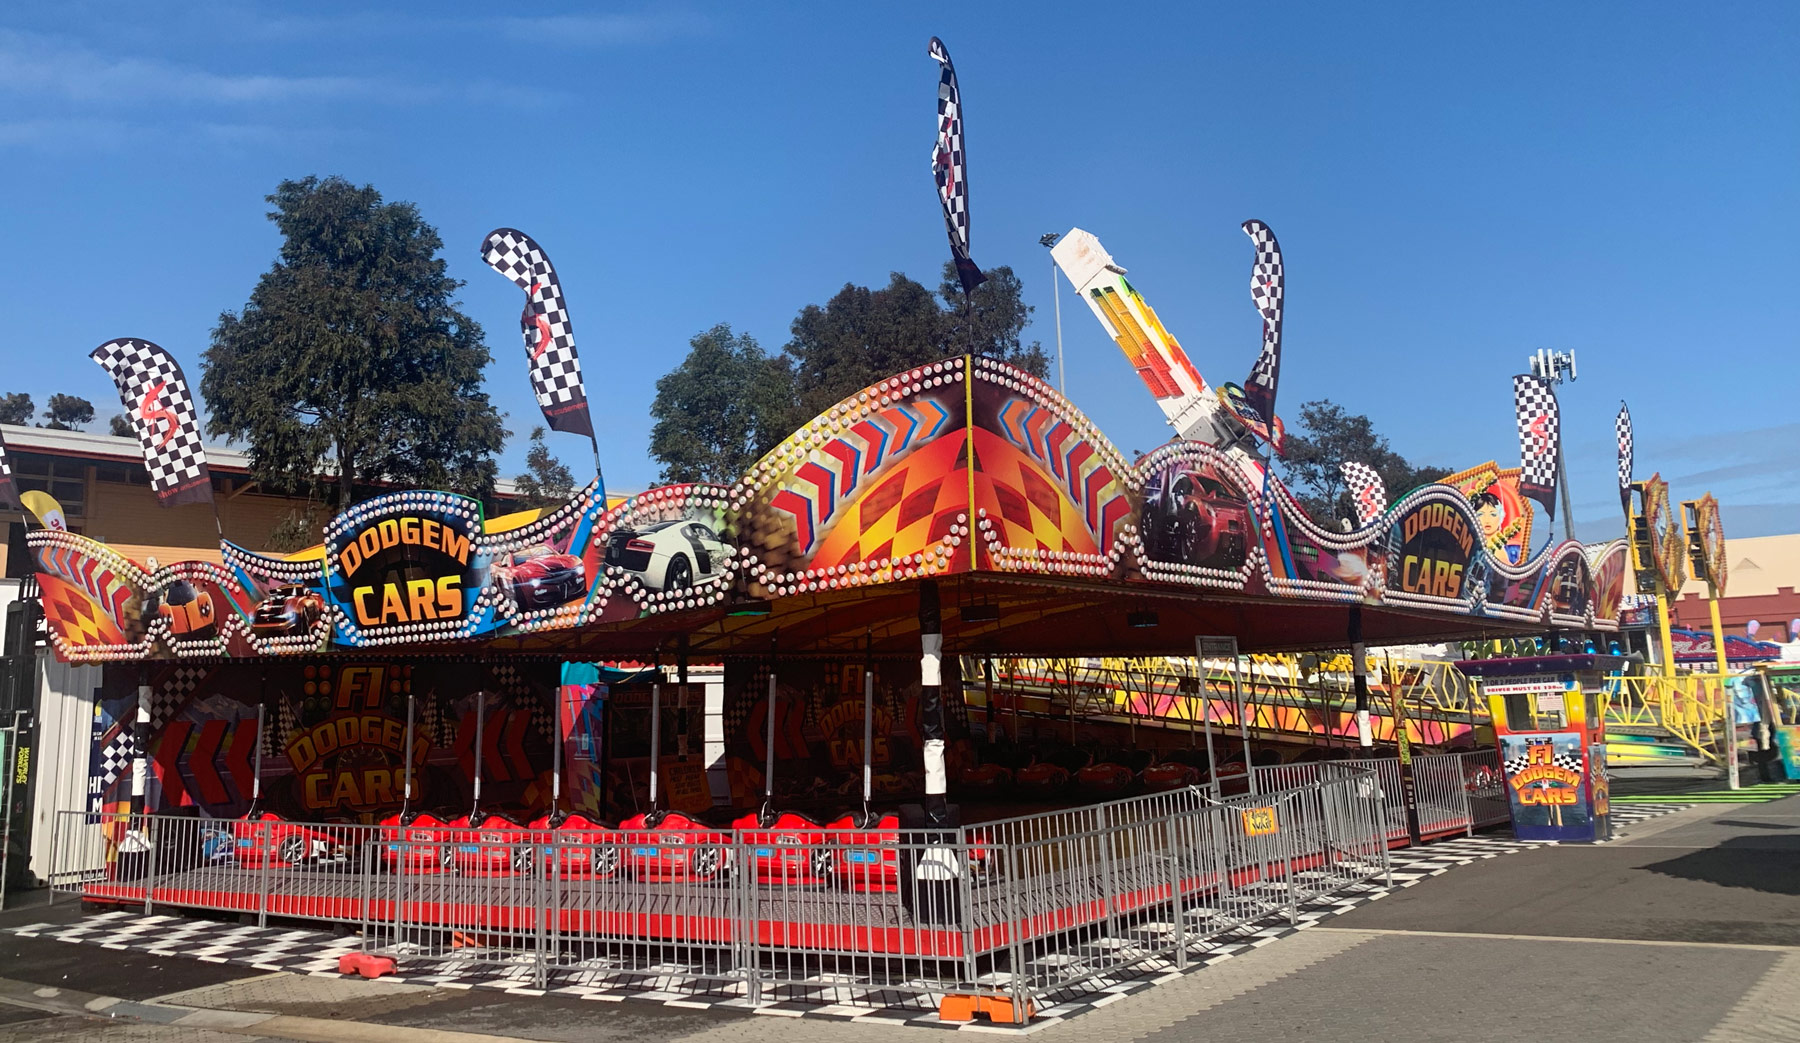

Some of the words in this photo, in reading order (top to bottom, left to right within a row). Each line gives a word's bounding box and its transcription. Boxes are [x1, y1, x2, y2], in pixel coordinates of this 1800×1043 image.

[340, 517, 470, 577] DODGEM
[1405, 503, 1474, 559] DODGEM
[1402, 554, 1463, 598] CARS
[353, 575, 462, 626] CARS
[337, 667, 384, 707] F1
[1529, 745, 1551, 765] F1
[305, 768, 418, 809] CARS
[1510, 766, 1581, 790] DODGEM
[1519, 788, 1577, 805] CARS
